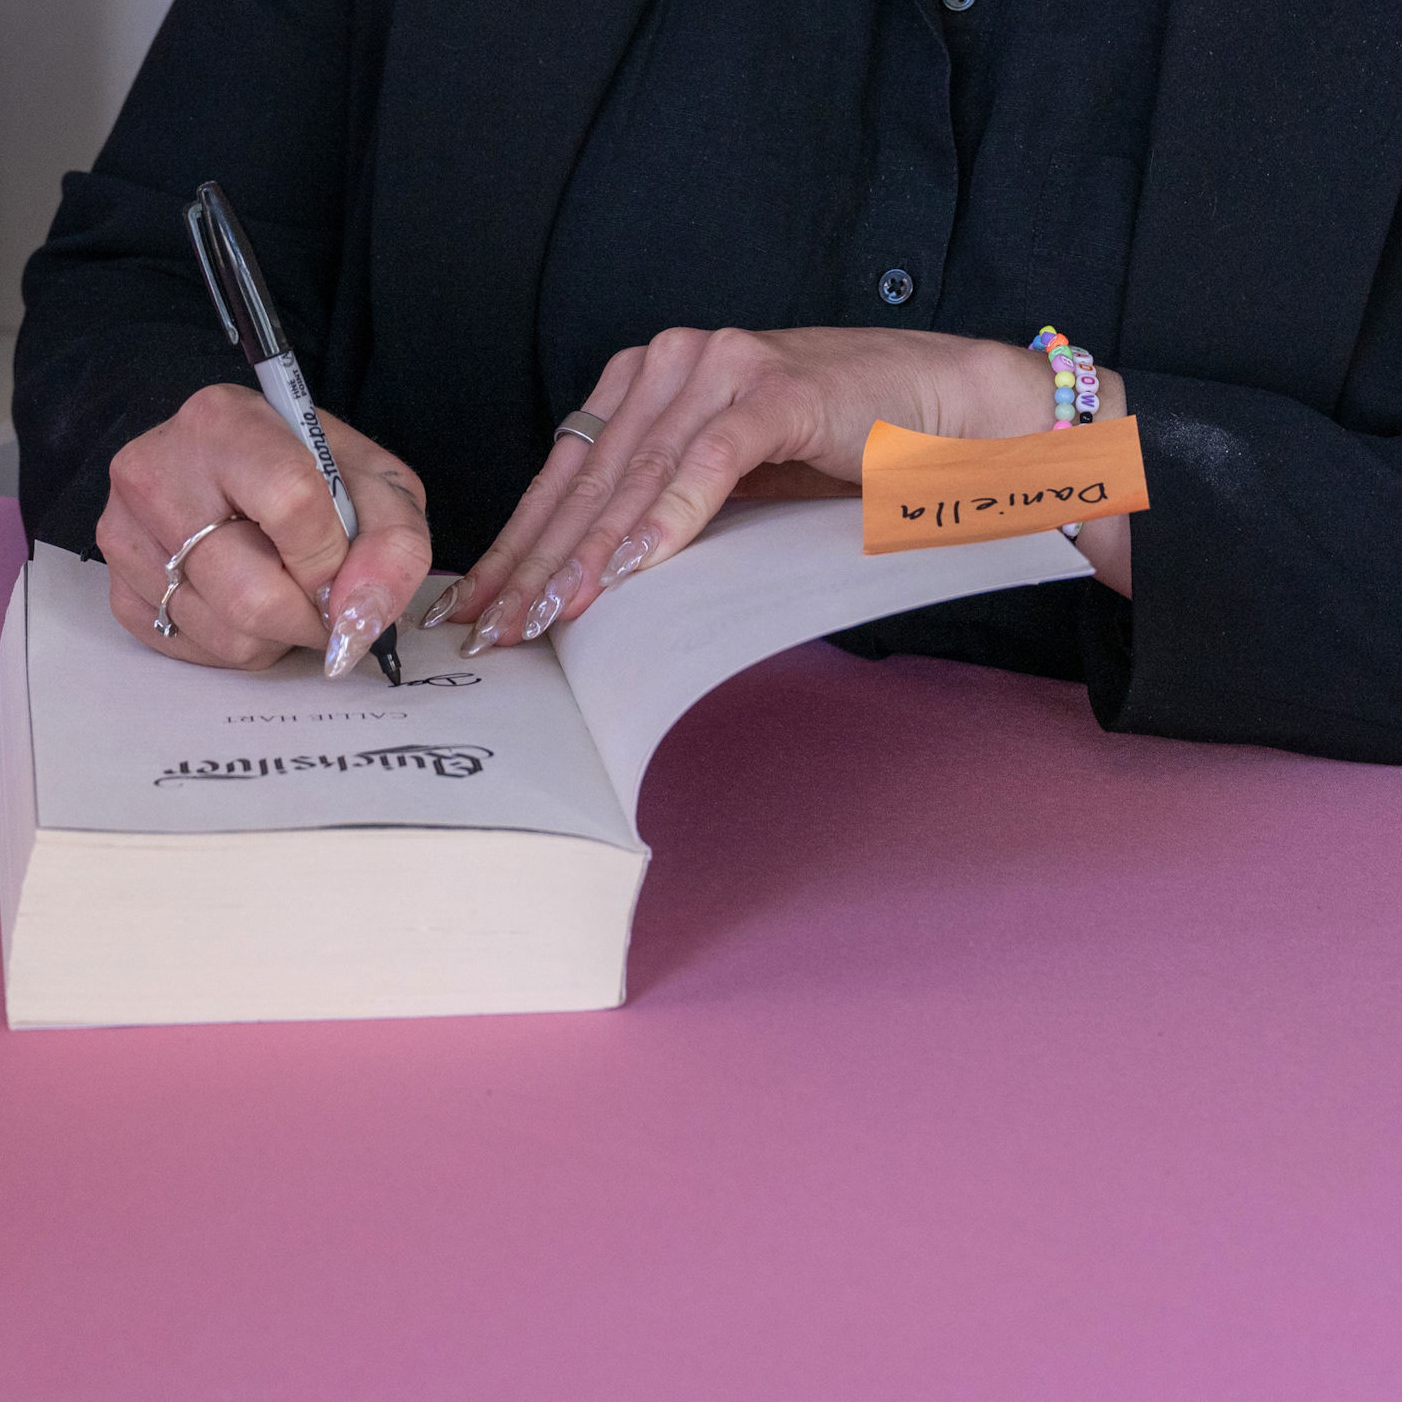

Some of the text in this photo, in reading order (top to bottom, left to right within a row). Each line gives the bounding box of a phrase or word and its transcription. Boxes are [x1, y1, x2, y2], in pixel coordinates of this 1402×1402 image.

[289, 379, 301, 399] FINE
[293, 369, 308, 397] POINT
[900, 481, 1109, 528] Daniella
[223, 710, 409, 724] CALLIE HART
[153, 742, 495, 788] Quicksilver
